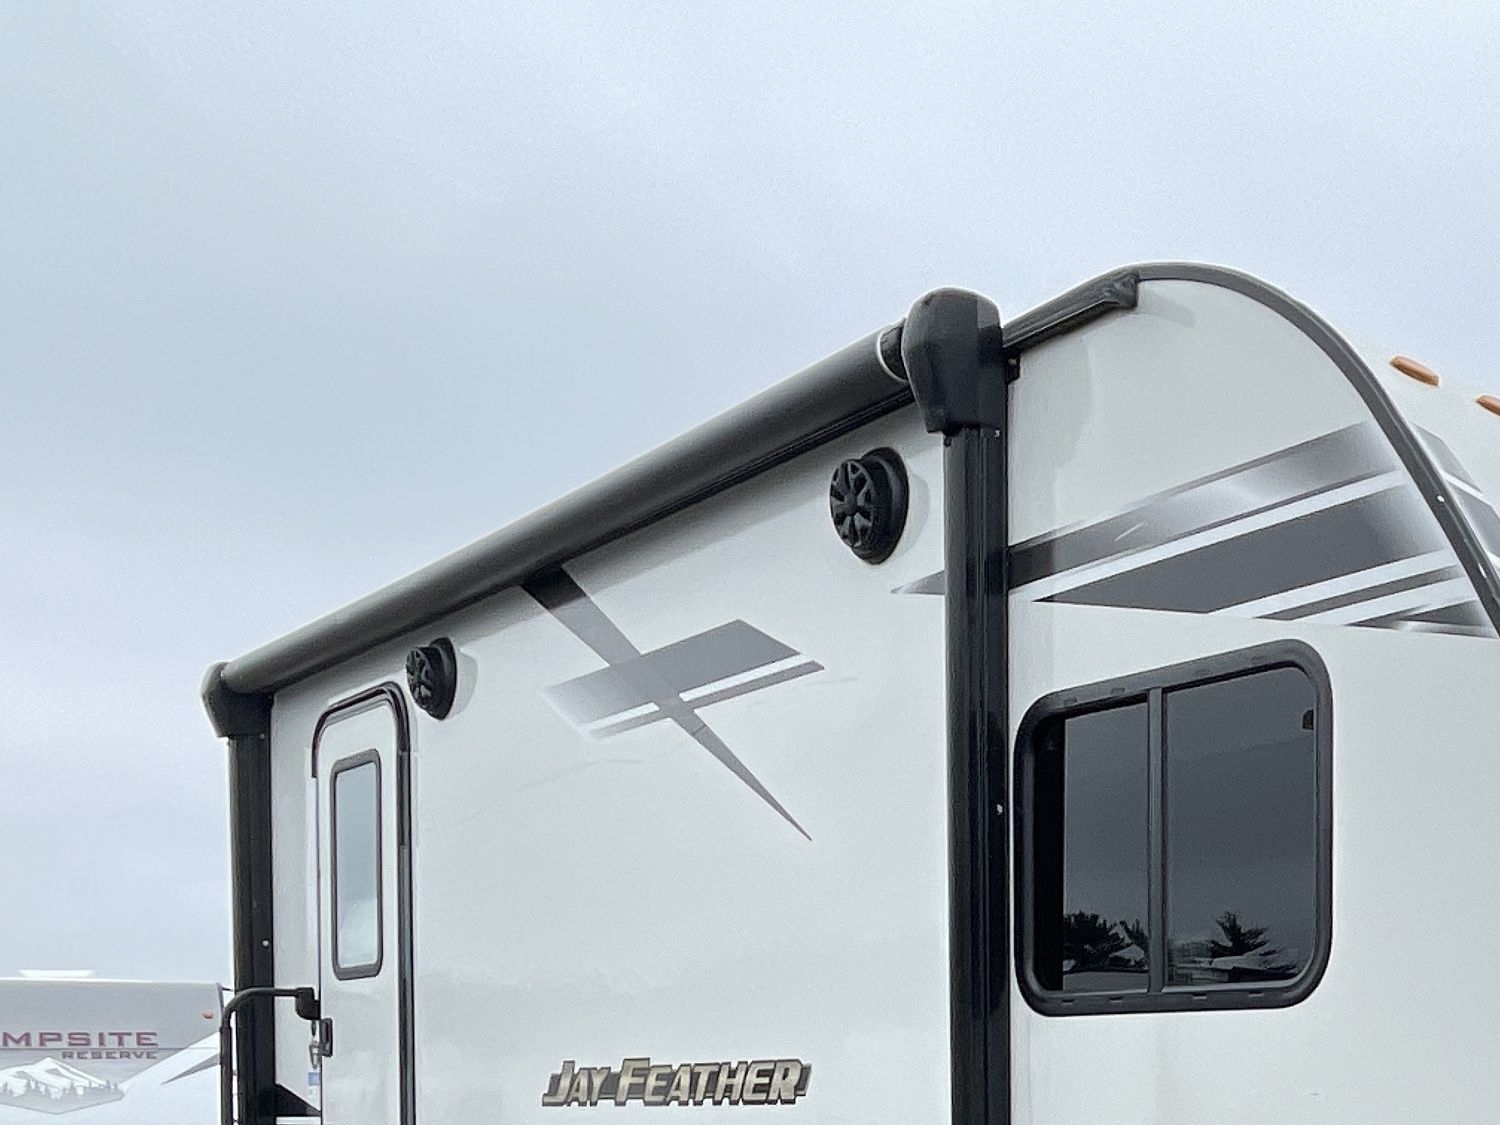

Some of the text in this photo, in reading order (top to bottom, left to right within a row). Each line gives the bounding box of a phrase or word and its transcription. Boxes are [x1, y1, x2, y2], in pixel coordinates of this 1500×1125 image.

[1, 1031, 159, 1047] MPSITE
[61, 1050, 158, 1060] RESERVE
[542, 1057, 802, 1106] JAY FEATHER
